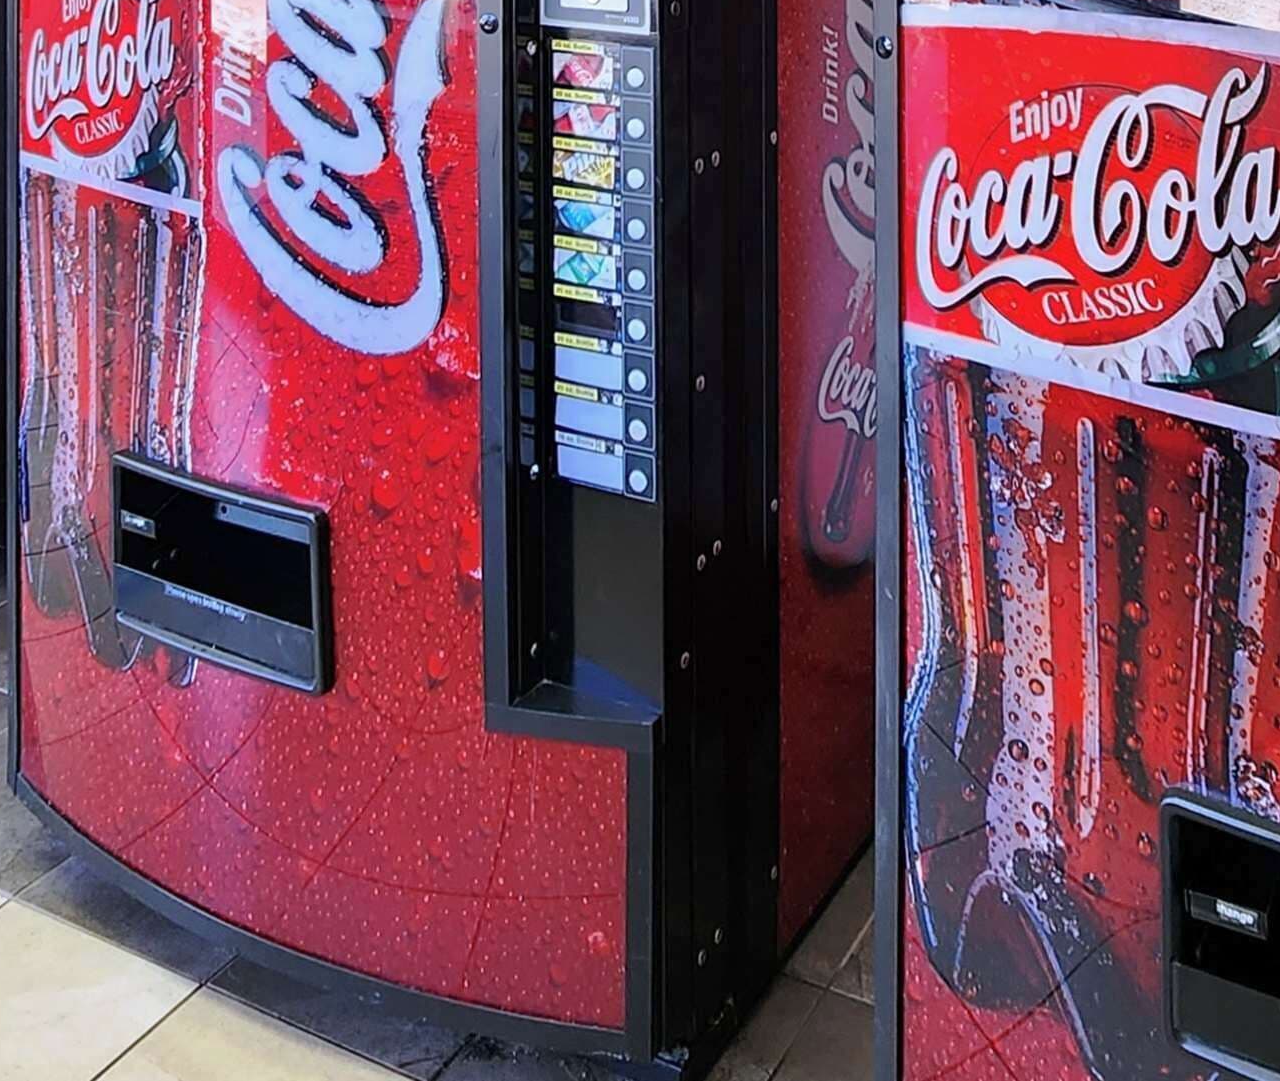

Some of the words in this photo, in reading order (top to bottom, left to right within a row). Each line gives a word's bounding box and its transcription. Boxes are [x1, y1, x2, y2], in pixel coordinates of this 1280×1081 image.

[823, 25, 839, 124] Drink!
[75, 108, 125, 145] CLASSIC
[1009, 88, 1084, 144] Enjoy
[1041, 278, 1164, 325] CLASSIC
